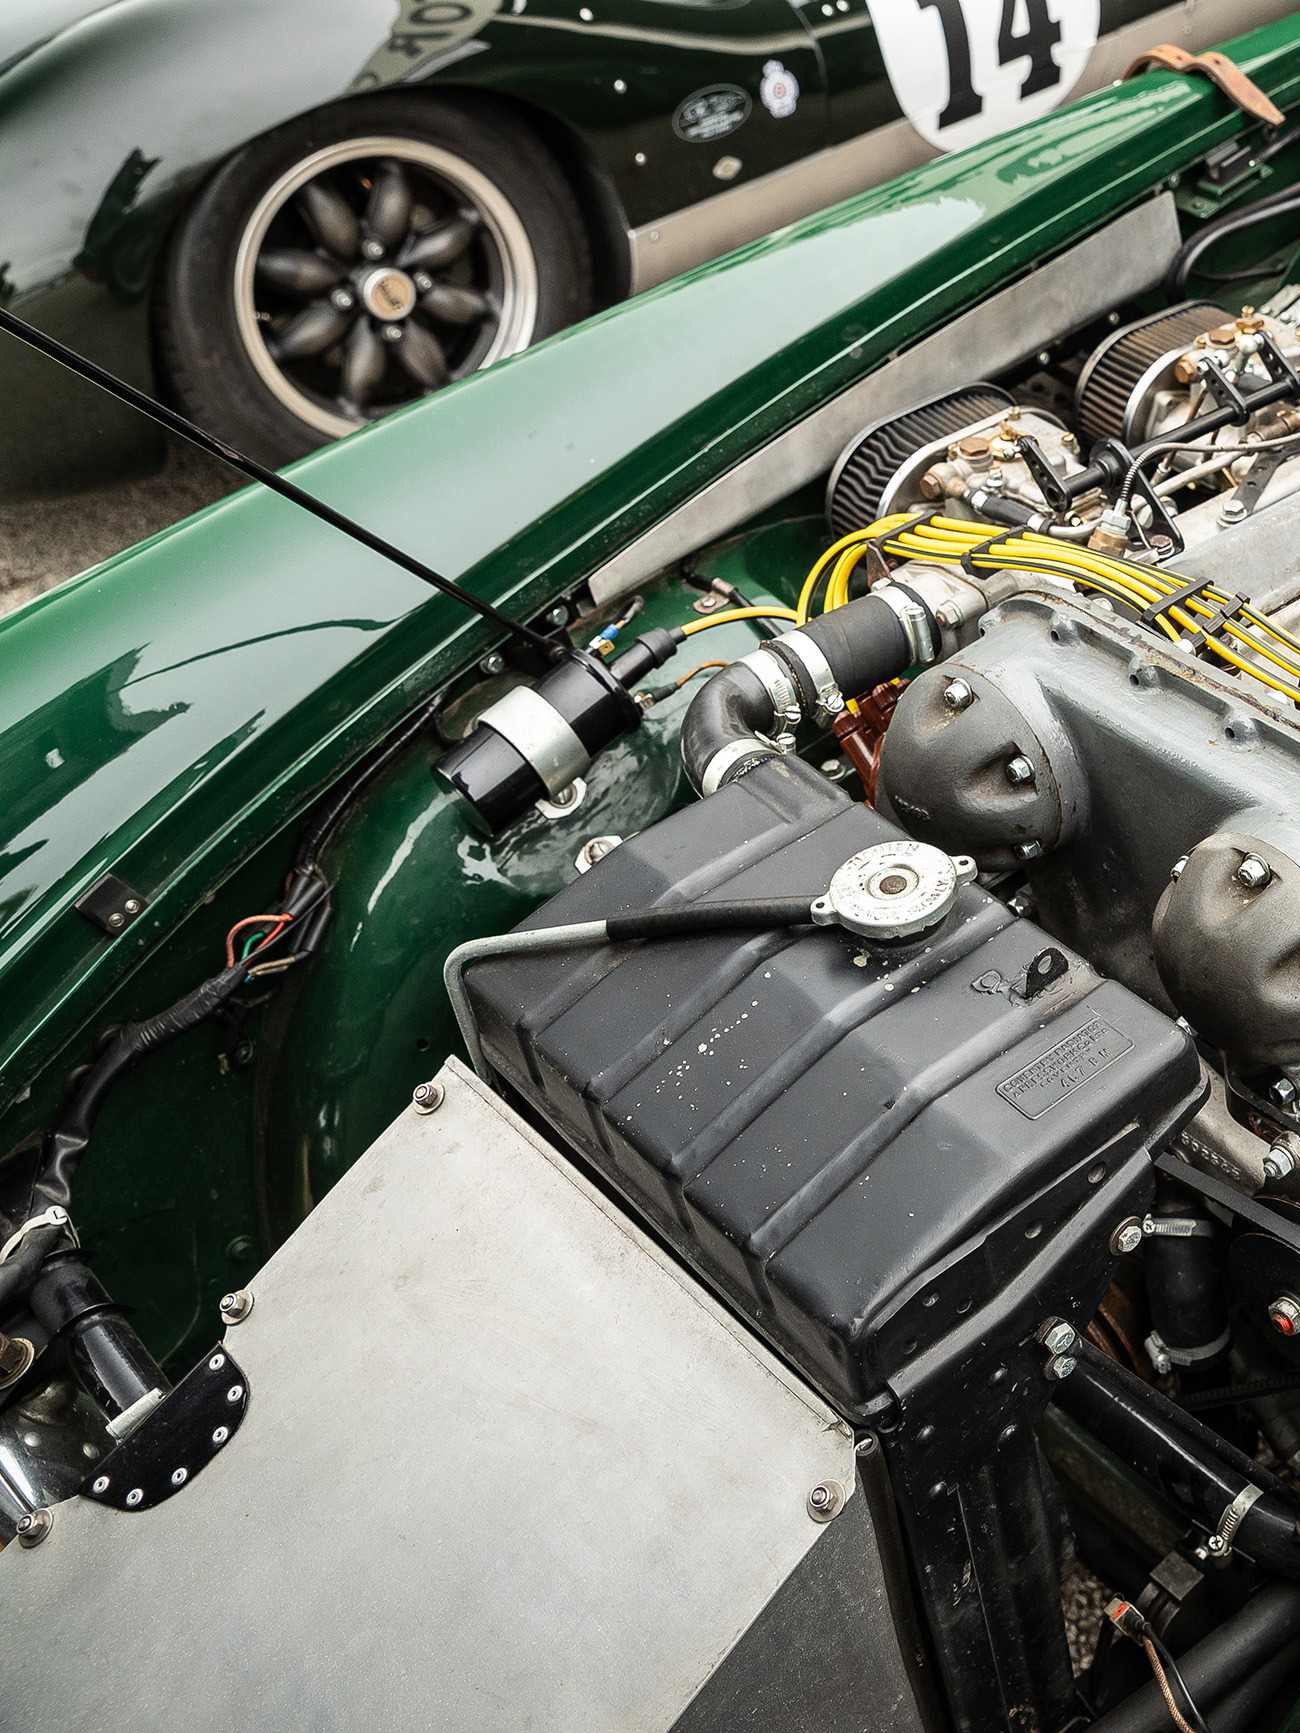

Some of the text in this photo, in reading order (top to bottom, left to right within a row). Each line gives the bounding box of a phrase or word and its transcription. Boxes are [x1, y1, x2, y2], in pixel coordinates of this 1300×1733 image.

[916, 0, 1062, 130] 14
[1003, 1021, 1101, 1092] COVENTRY RADIATOR
[1018, 1048, 1077, 1093] PRESSWORK
